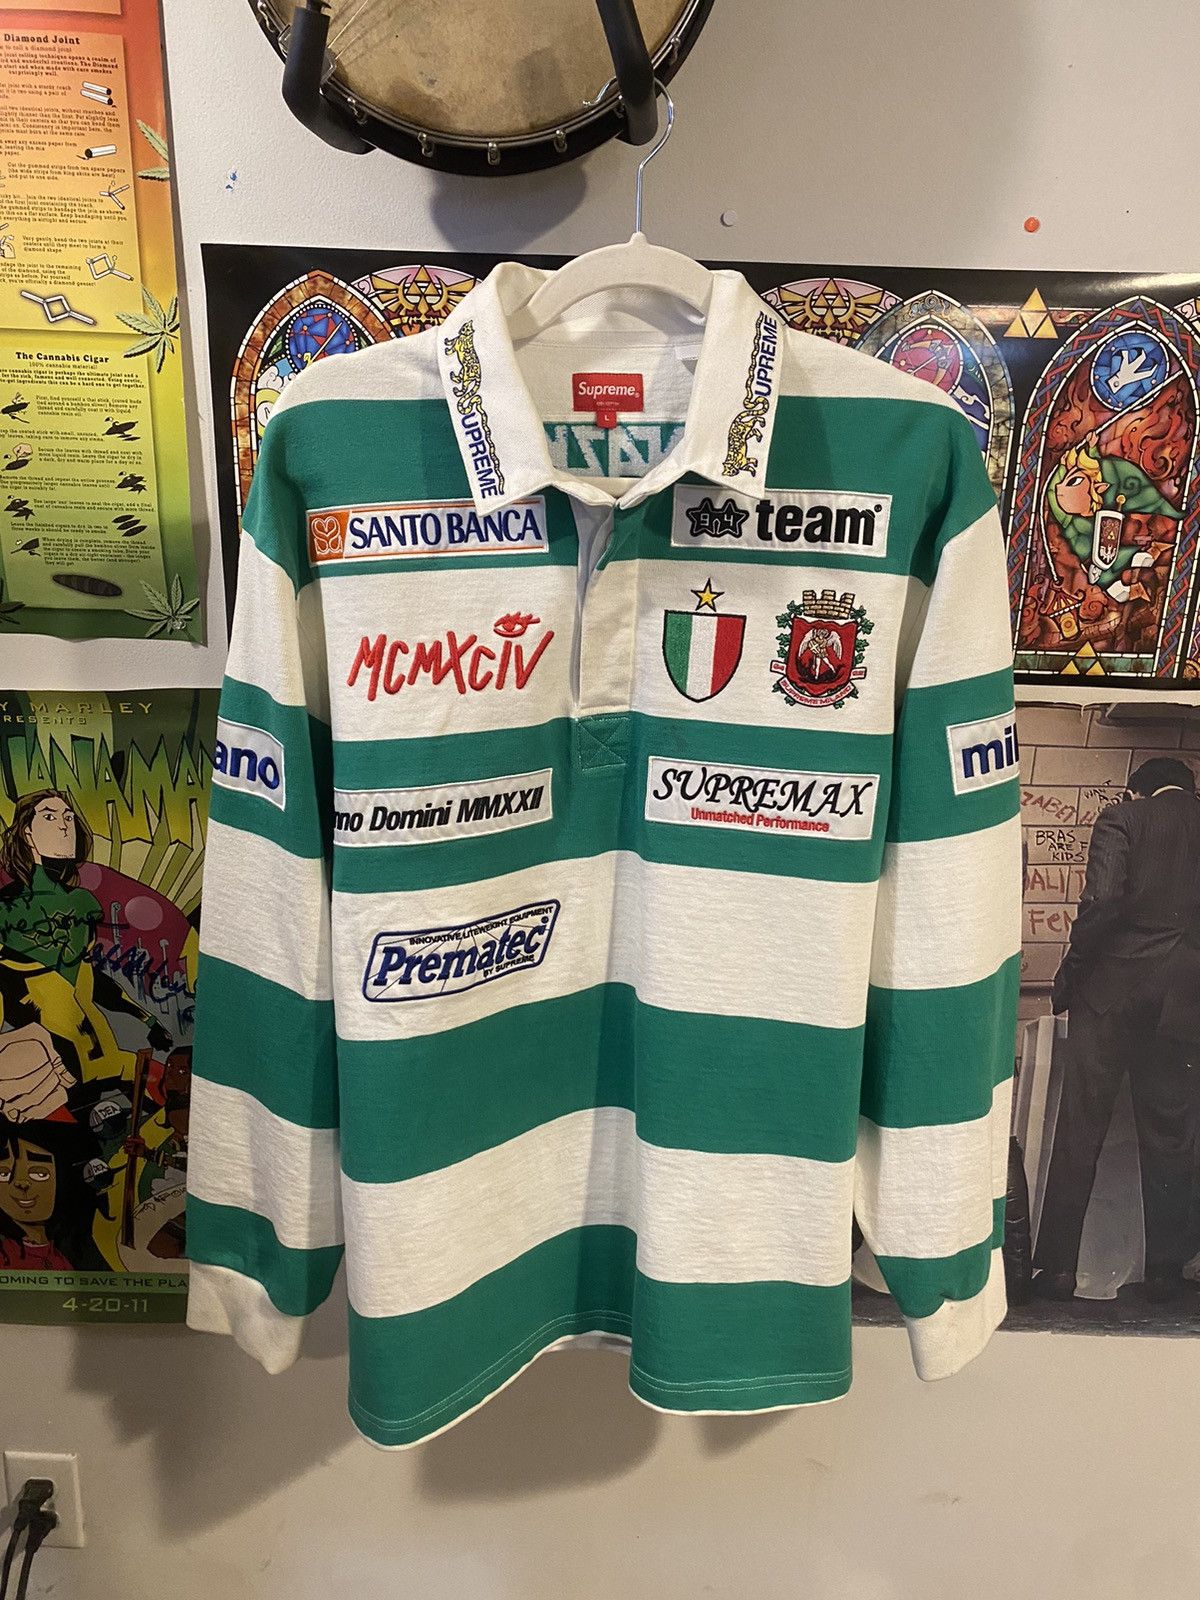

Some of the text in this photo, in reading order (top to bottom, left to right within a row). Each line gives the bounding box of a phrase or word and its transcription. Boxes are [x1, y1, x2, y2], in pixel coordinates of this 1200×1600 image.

[4, 34, 81, 45] Diamond Joint
[16, 352, 109, 363] The Cannabis Cigar
[578, 381, 636, 400] Supreme
[349, 508, 543, 550] SANTO BANCA
[755, 500, 876, 546] team
[346, 629, 555, 702] MCMXCIV
[31, 702, 152, 714] MARLEY
[3, 715, 87, 726] RESENTS
[213, 740, 280, 790] ano
[653, 766, 873, 818] SUPREMAX
[369, 800, 453, 831] Domini
[456, 786, 544, 823] MMXXII
[691, 807, 830, 833] Unmatched Performance
[1036, 830, 1076, 846] BRAS
[1048, 843, 1074, 852] ARE
[1052, 852, 1084, 862] KIDS
[410, 932, 462, 945] INNOVATIVE
[508, 906, 554, 924] EQUIPMENT
[373, 923, 547, 986] Prematec
[495, 955, 535, 972] SUPREME
[98, 1105, 118, 1118] DEA
[54, 1276, 74, 1285] TO
[80, 1277, 118, 1286] SAVE
[124, 1278, 153, 1287] THE
[62, 1297, 148, 1312] 4-20-11
